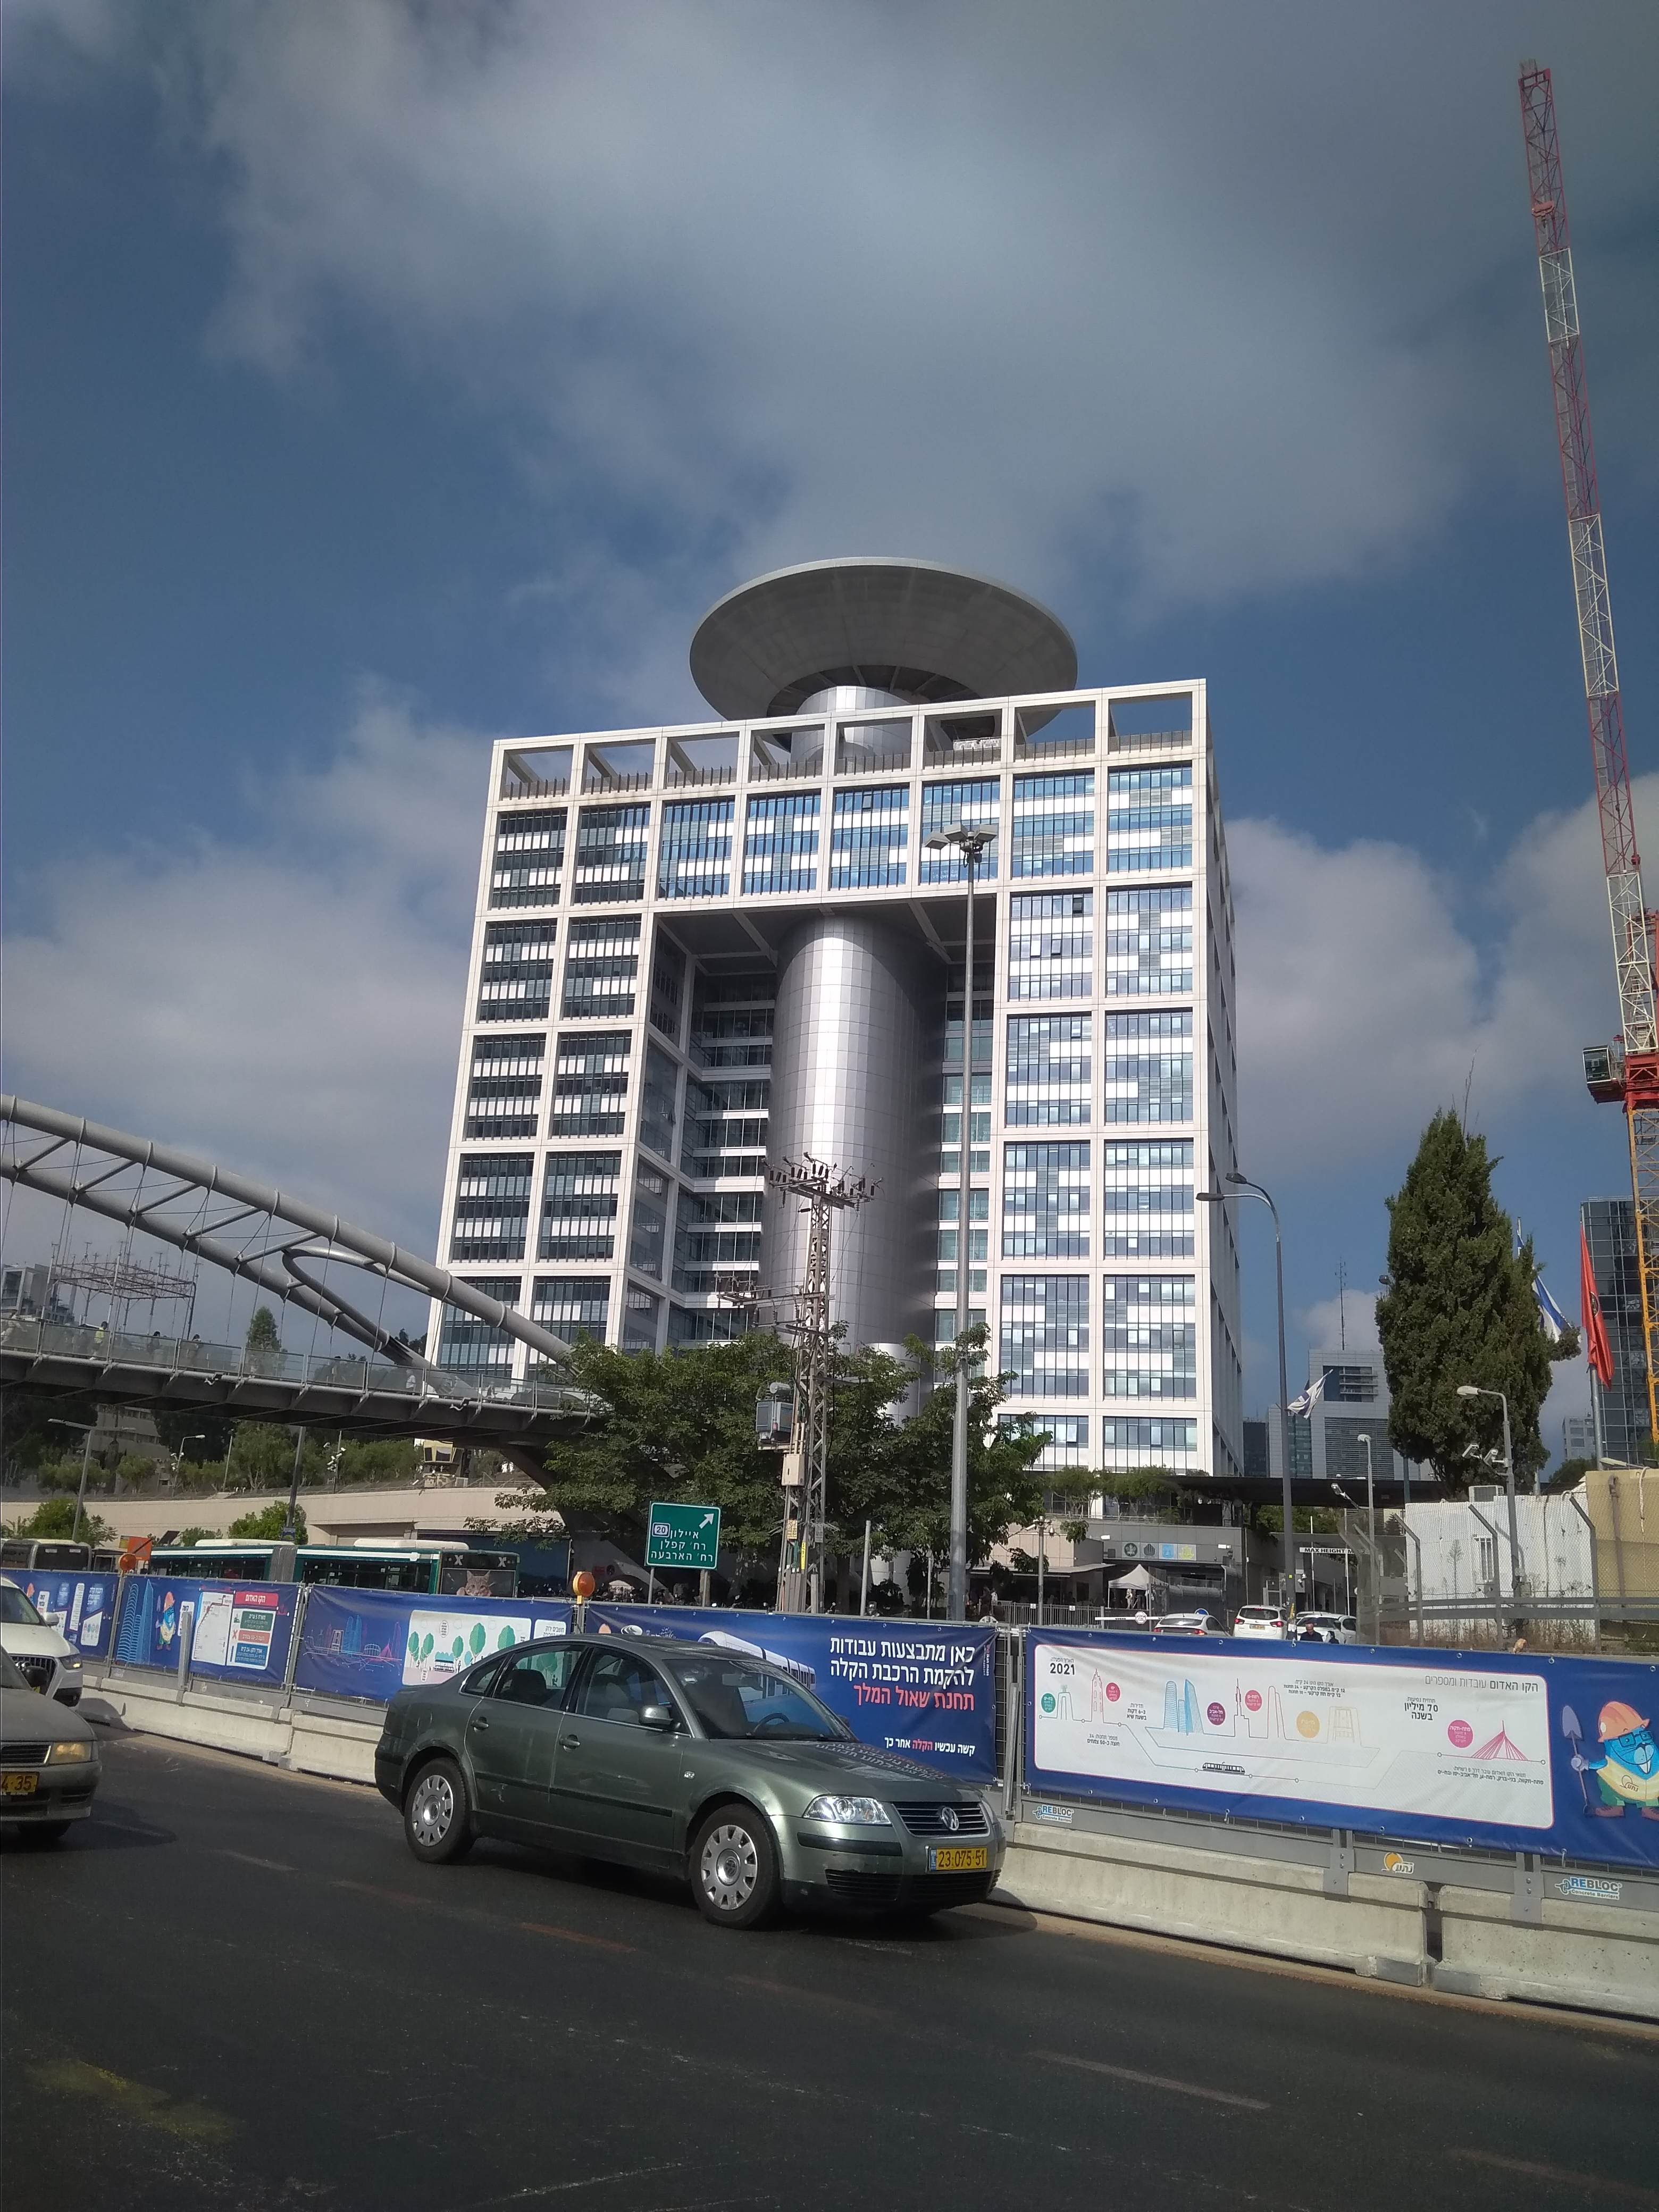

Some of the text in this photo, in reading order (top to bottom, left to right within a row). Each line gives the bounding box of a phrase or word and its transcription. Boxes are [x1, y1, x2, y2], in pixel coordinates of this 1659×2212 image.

[670, 1529, 699, 1539] איילון
[660, 1539, 685, 1551] קפלן
[651, 1551, 692, 1560] הארבעה
[830, 1637, 876, 1656] עבודות
[881, 1641, 945, 1662] מתבצעות
[950, 1645, 975, 1666] כאן
[831, 1657, 974, 1689] להקמת הרכבת הקלה
[1050, 1663, 1075, 1675] 2021
[1425, 1675, 1538, 1693] הקו האדום עובדות ומספרים
[853, 1682, 974, 1711] תחנת שאול המלך
[1404, 1702, 1425, 1711] מיליון
[1412, 1712, 1433, 1720] בשנה
[884, 1737, 975, 1757] קשה עכשיו הקלה אחר כך
